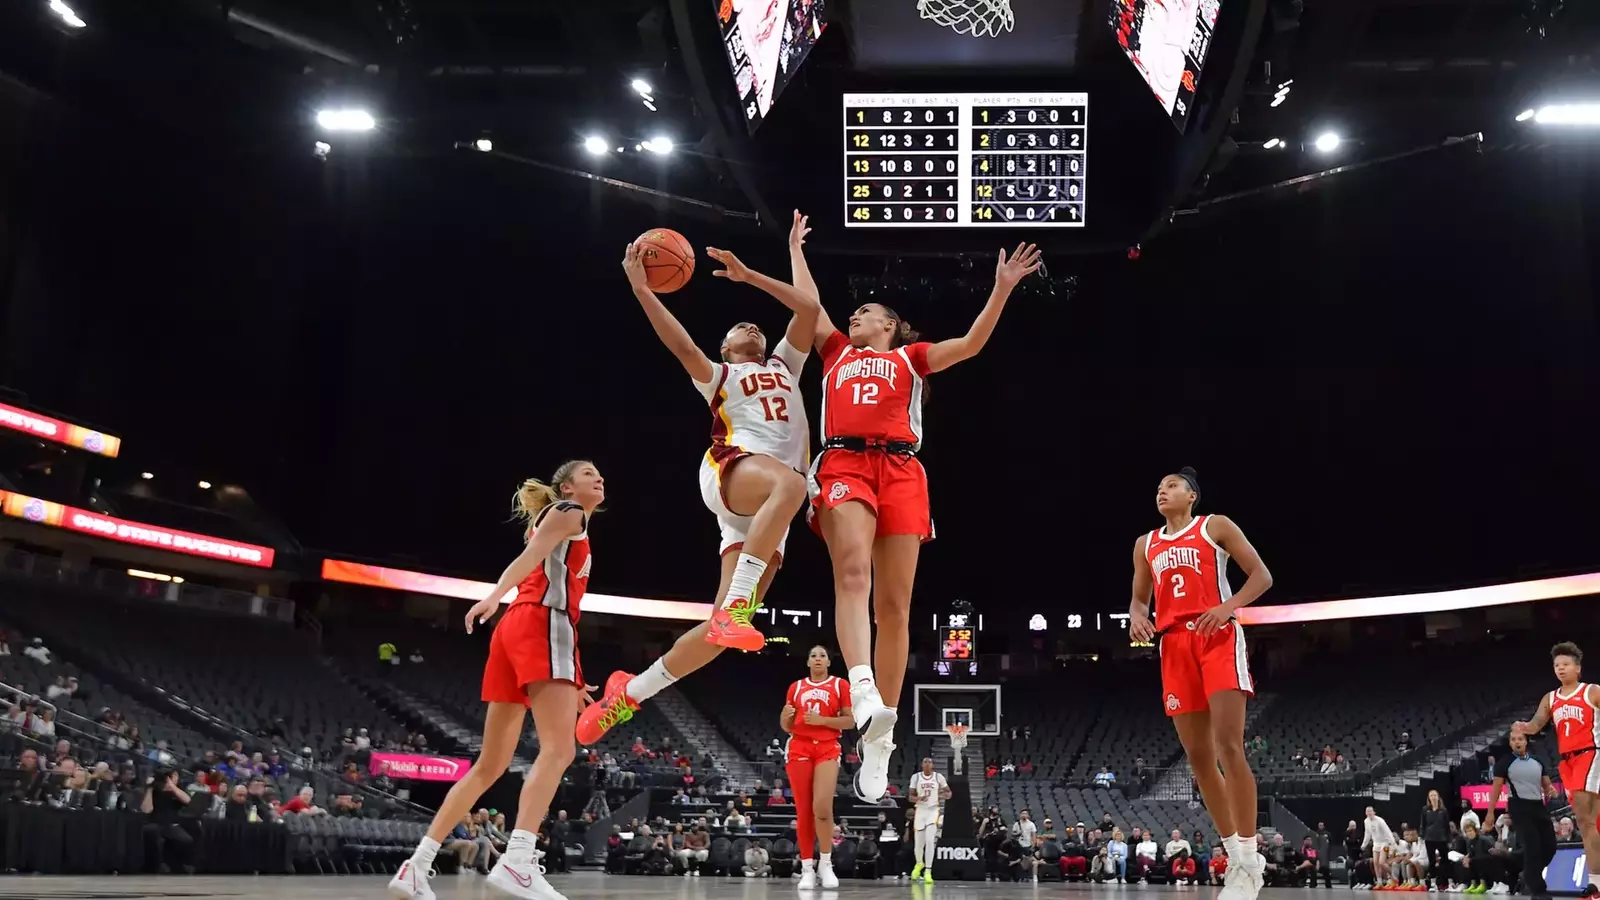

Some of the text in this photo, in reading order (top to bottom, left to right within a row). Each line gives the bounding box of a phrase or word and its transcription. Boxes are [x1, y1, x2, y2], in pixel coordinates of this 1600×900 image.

[857, 110, 954, 123] 1 8 2 0 1
[981, 110, 1079, 123] 1 3 0 0 1
[853, 134, 954, 147] 12 12 3 2 1
[980, 134, 1079, 146] 2 0 3 0 2
[853, 160, 955, 172] 13 10 8 0 0
[980, 159, 1079, 172] 4 8 2 1 0
[853, 185, 953, 197] 25 0 2 1 1
[976, 184, 1079, 197] 12 5 1 2 0
[853, 207, 955, 220] 45 3 0 2 0
[975, 207, 1077, 220] 14 0 0 1 1
[835, 357, 898, 391] OHIO STATE
[739, 373, 792, 397] USC
[852, 382, 879, 405] 12
[759, 396, 789, 422] 12
[72, 513, 262, 562] OHIO STATE BUCKEYES
[1168, 546, 1203, 575] STATE
[1170, 573, 1187, 598] 2
[792, 616, 799, 625] 4
[1067, 614, 1082, 628] 23
[1120, 618, 1127, 629] 2
[949, 630, 971, 640] 2:52
[1563, 721, 1570, 737] 1
[420, 764, 452, 775] ARENA
[937, 846, 980, 861] max
